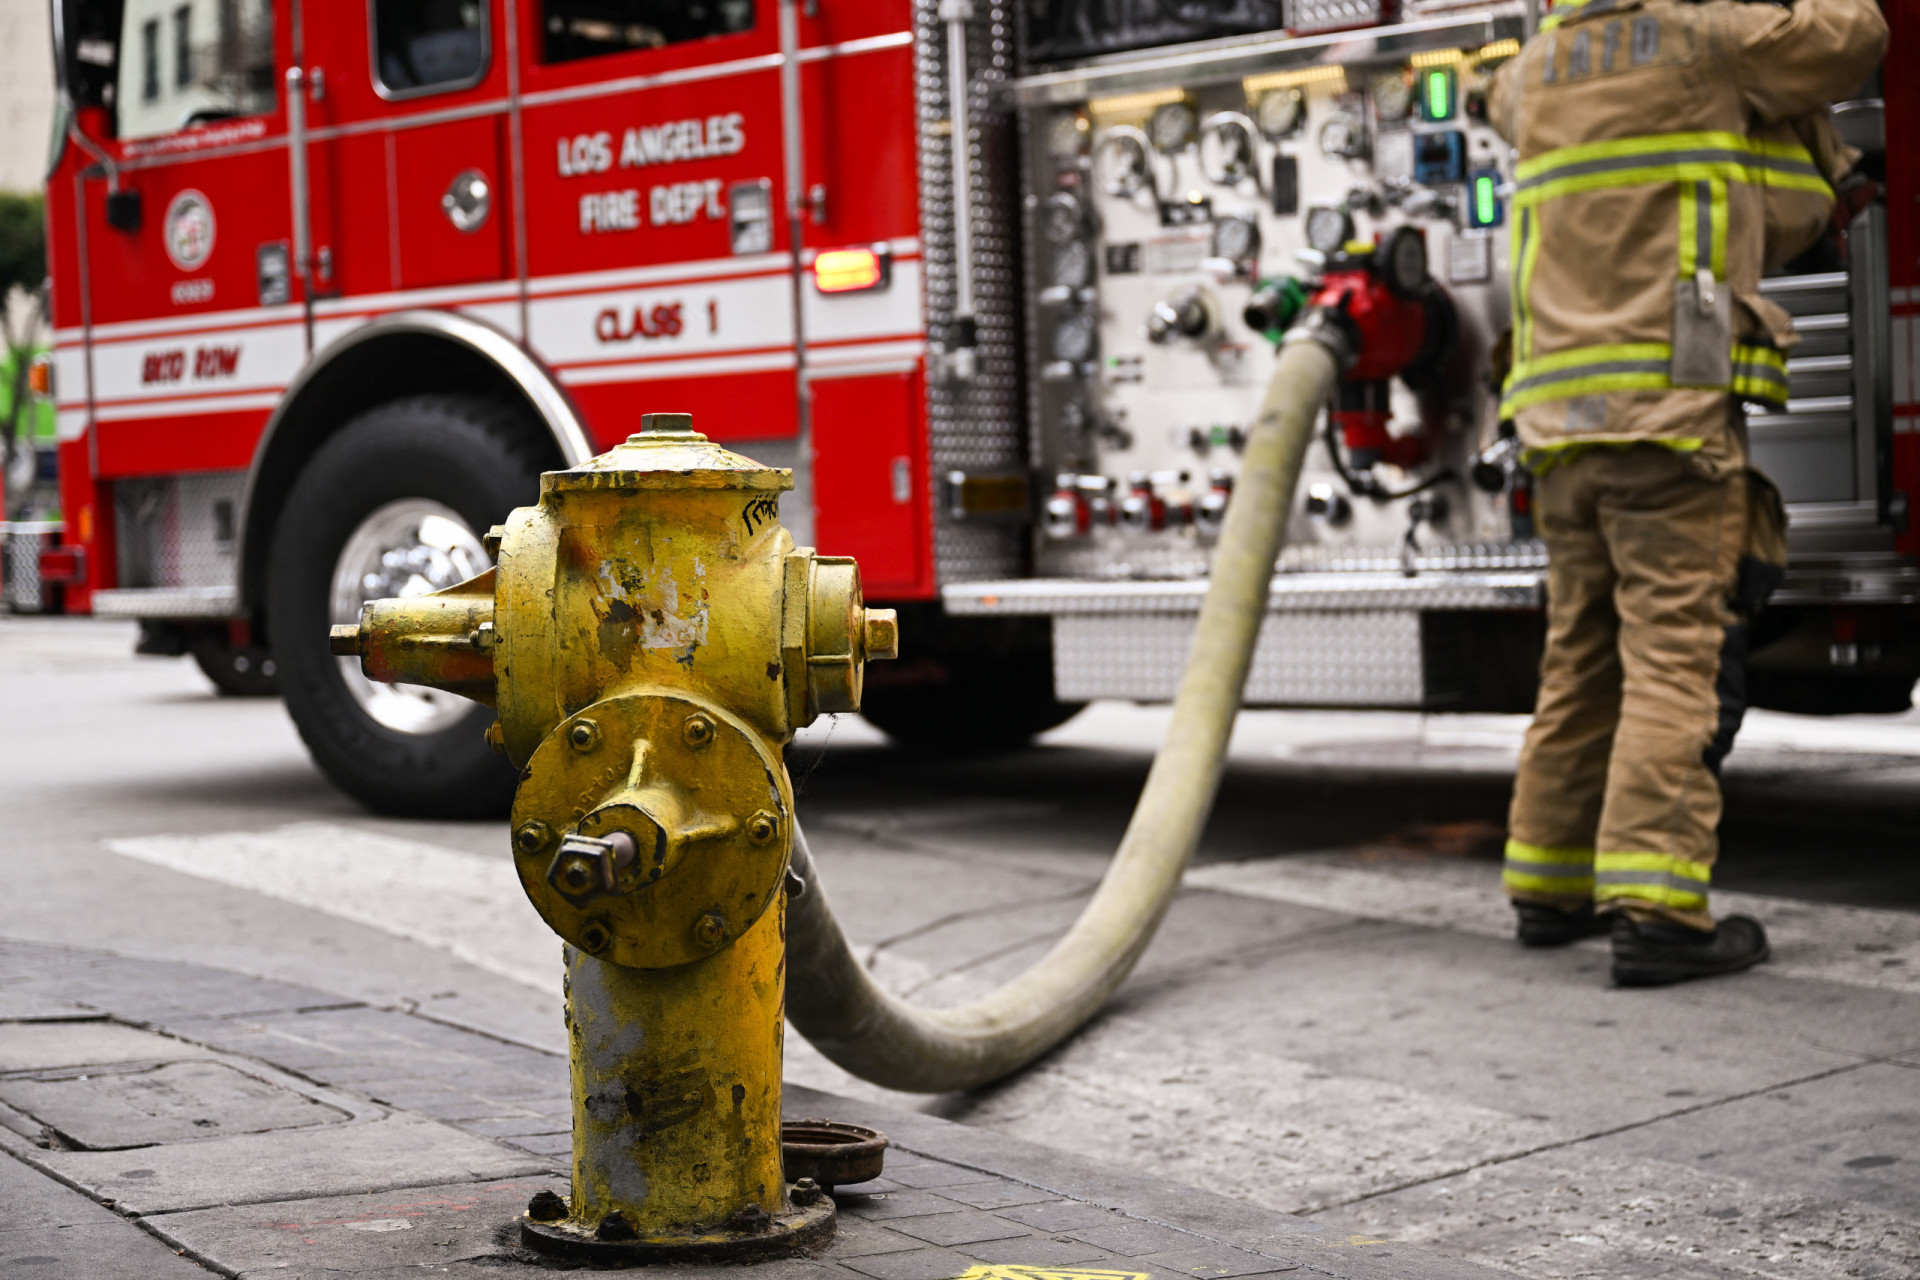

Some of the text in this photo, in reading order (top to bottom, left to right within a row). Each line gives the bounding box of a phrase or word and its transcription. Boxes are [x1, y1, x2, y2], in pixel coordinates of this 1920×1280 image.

[1542, 15, 1661, 85] LAFD
[557, 111, 746, 177] LOS ANGELES
[579, 177, 727, 235] FIRE DEPT.
[595, 300, 719, 342] CLASS 1
[194, 345, 242, 379] ROW
